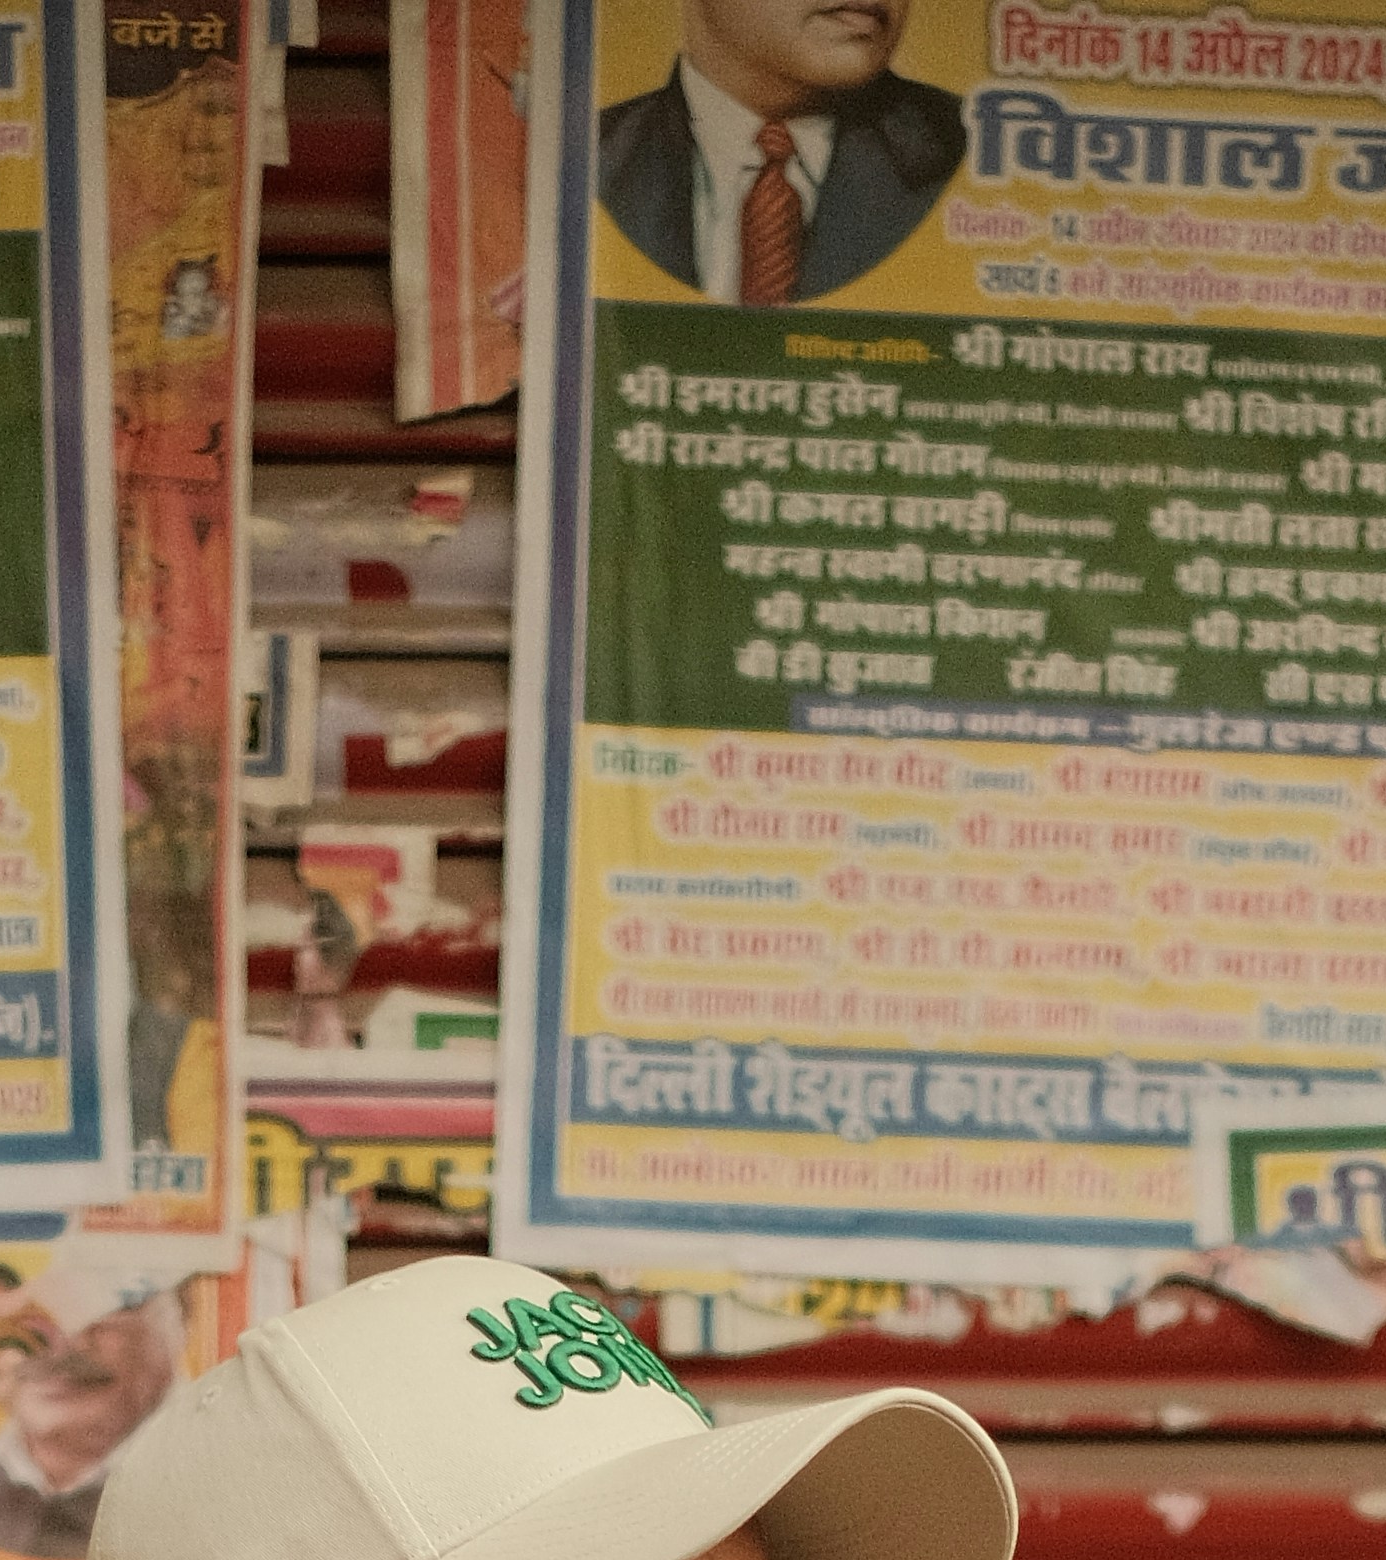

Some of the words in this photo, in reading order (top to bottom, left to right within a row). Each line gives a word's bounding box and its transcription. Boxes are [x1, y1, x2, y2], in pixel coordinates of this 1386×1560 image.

[1002, 7, 1124, 68] दिनांक
[1137, 28, 1173, 73] 14
[1183, 18, 1290, 77] अप्रैल
[974, 88, 1316, 192] विशाल
[952, 323, 1005, 369] श्री
[1010, 326, 1135, 375] गोपाल
[1140, 342, 1211, 377] राय
[621, 365, 671, 409] श्री
[674, 375, 800, 415] इमरान
[1183, 390, 1234, 435] श्री
[586, 1033, 736, 1115] दिल्ली
